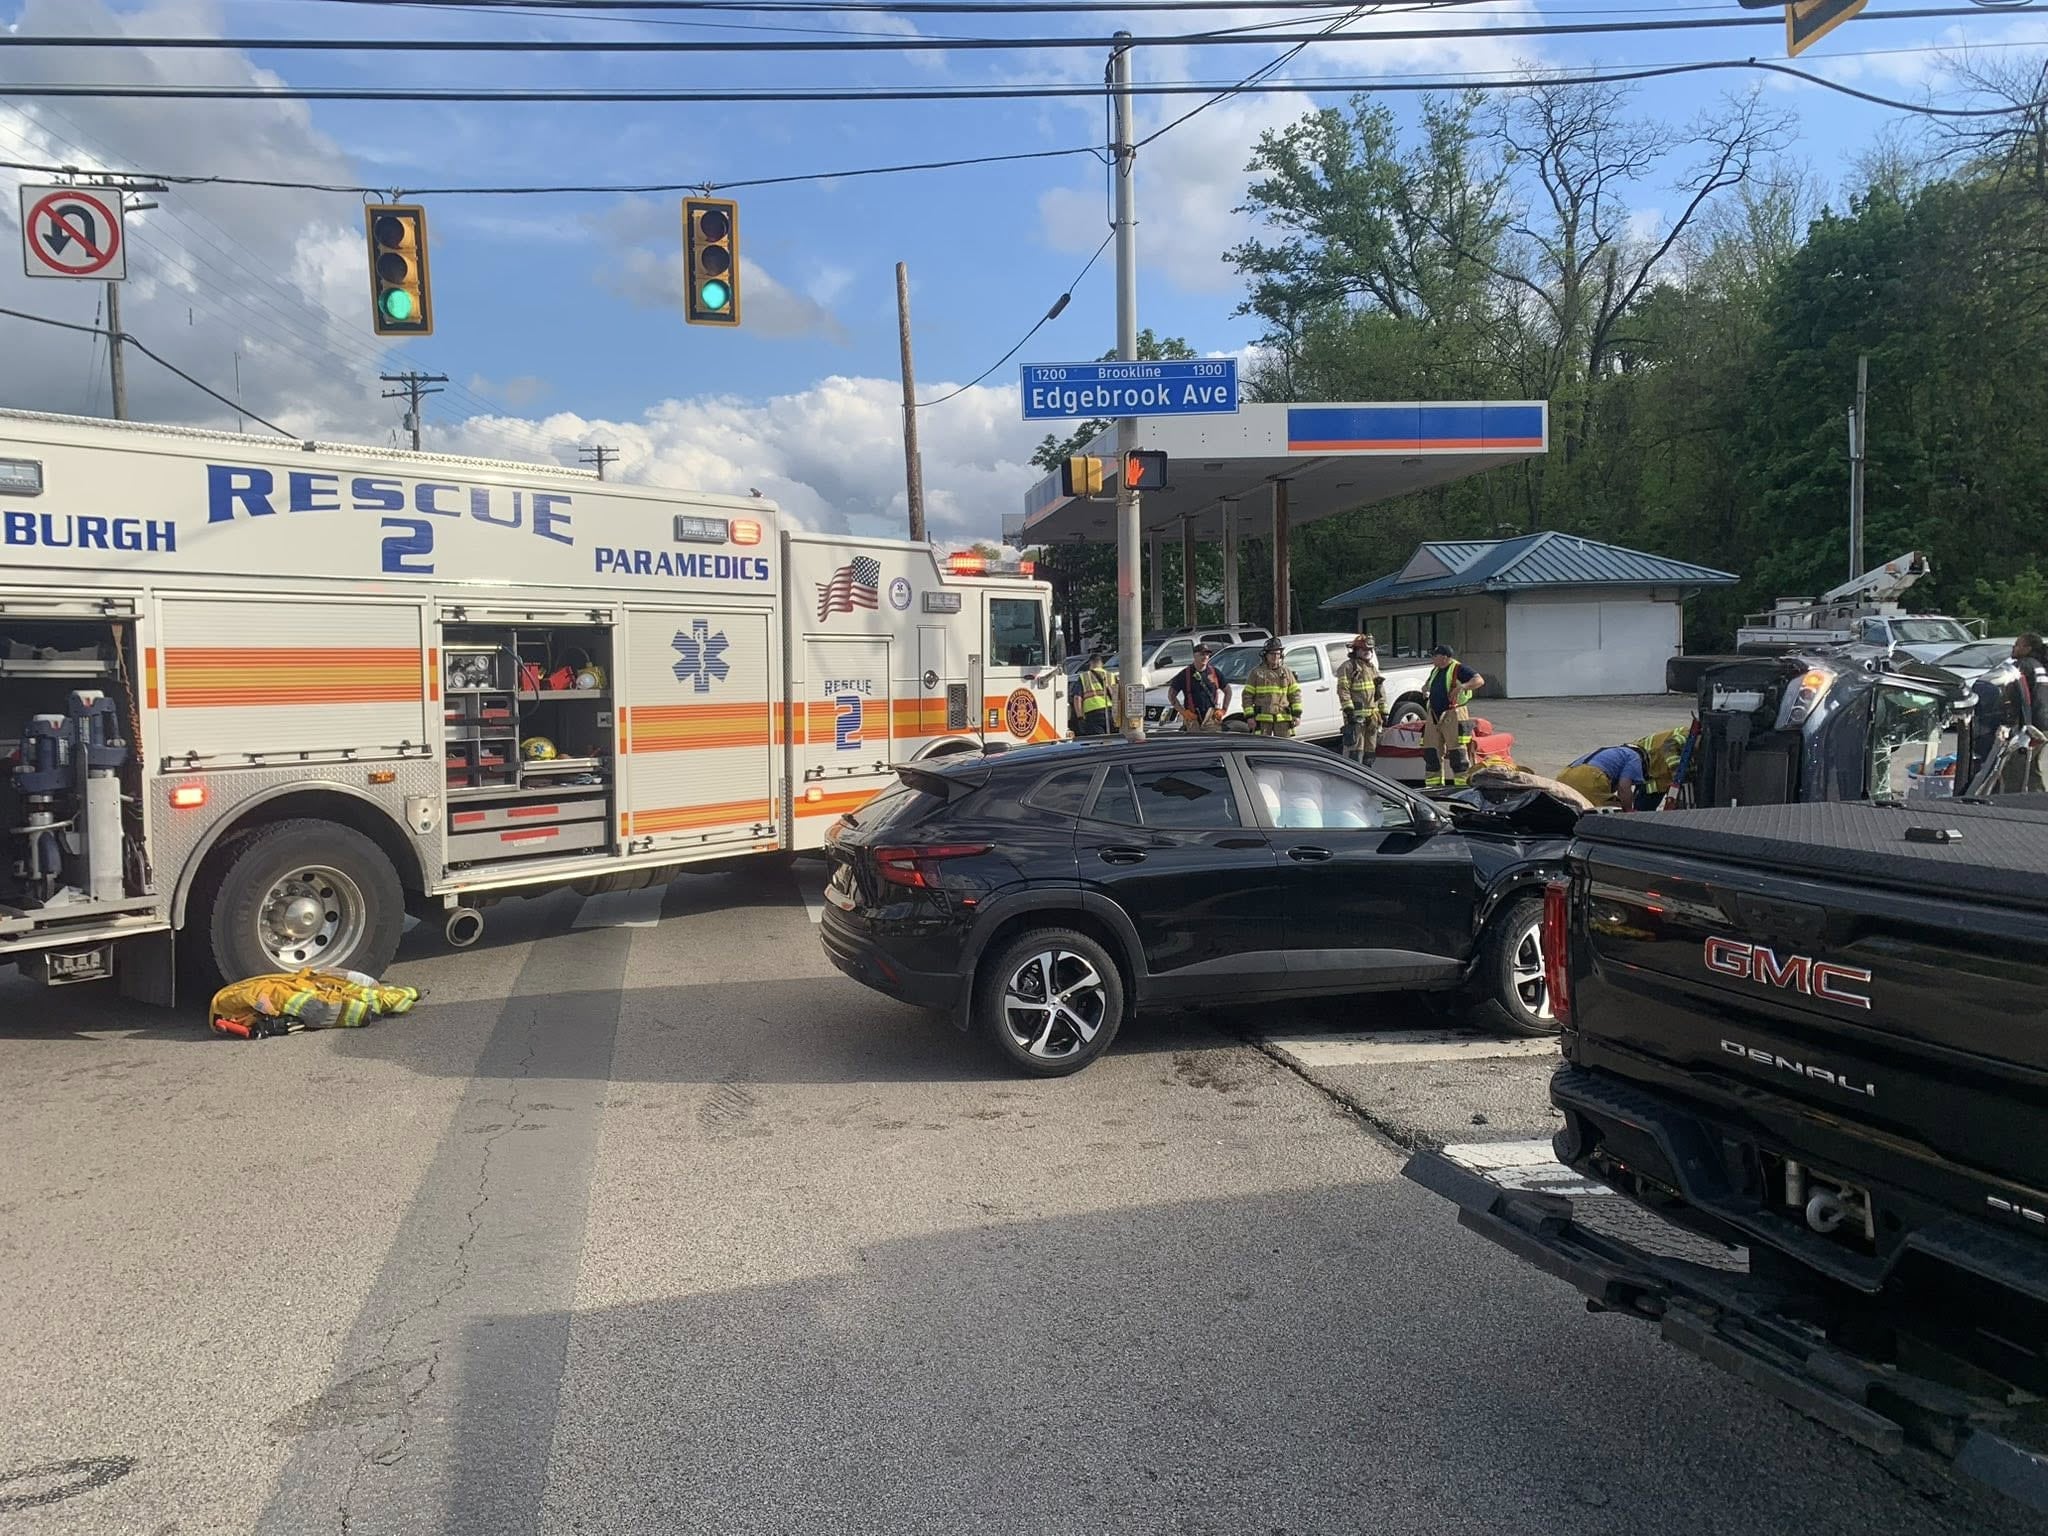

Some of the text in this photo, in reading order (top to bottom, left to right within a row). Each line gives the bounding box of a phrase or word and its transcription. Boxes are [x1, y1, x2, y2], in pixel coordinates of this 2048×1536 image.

[1036, 364, 1222, 380] 1200 Brookline 1300
[1032, 384, 1228, 413] Edgebrook Ave
[207, 464, 574, 546] RESCUE
[4, 511, 176, 552] BURGH
[381, 517, 434, 574] 2
[595, 547, 769, 581] PARAMEDICS
[824, 679, 872, 696] RESCUE
[836, 696, 861, 749] 2
[1704, 936, 1872, 1010] GMC
[1721, 1039, 1875, 1096] DENALI
